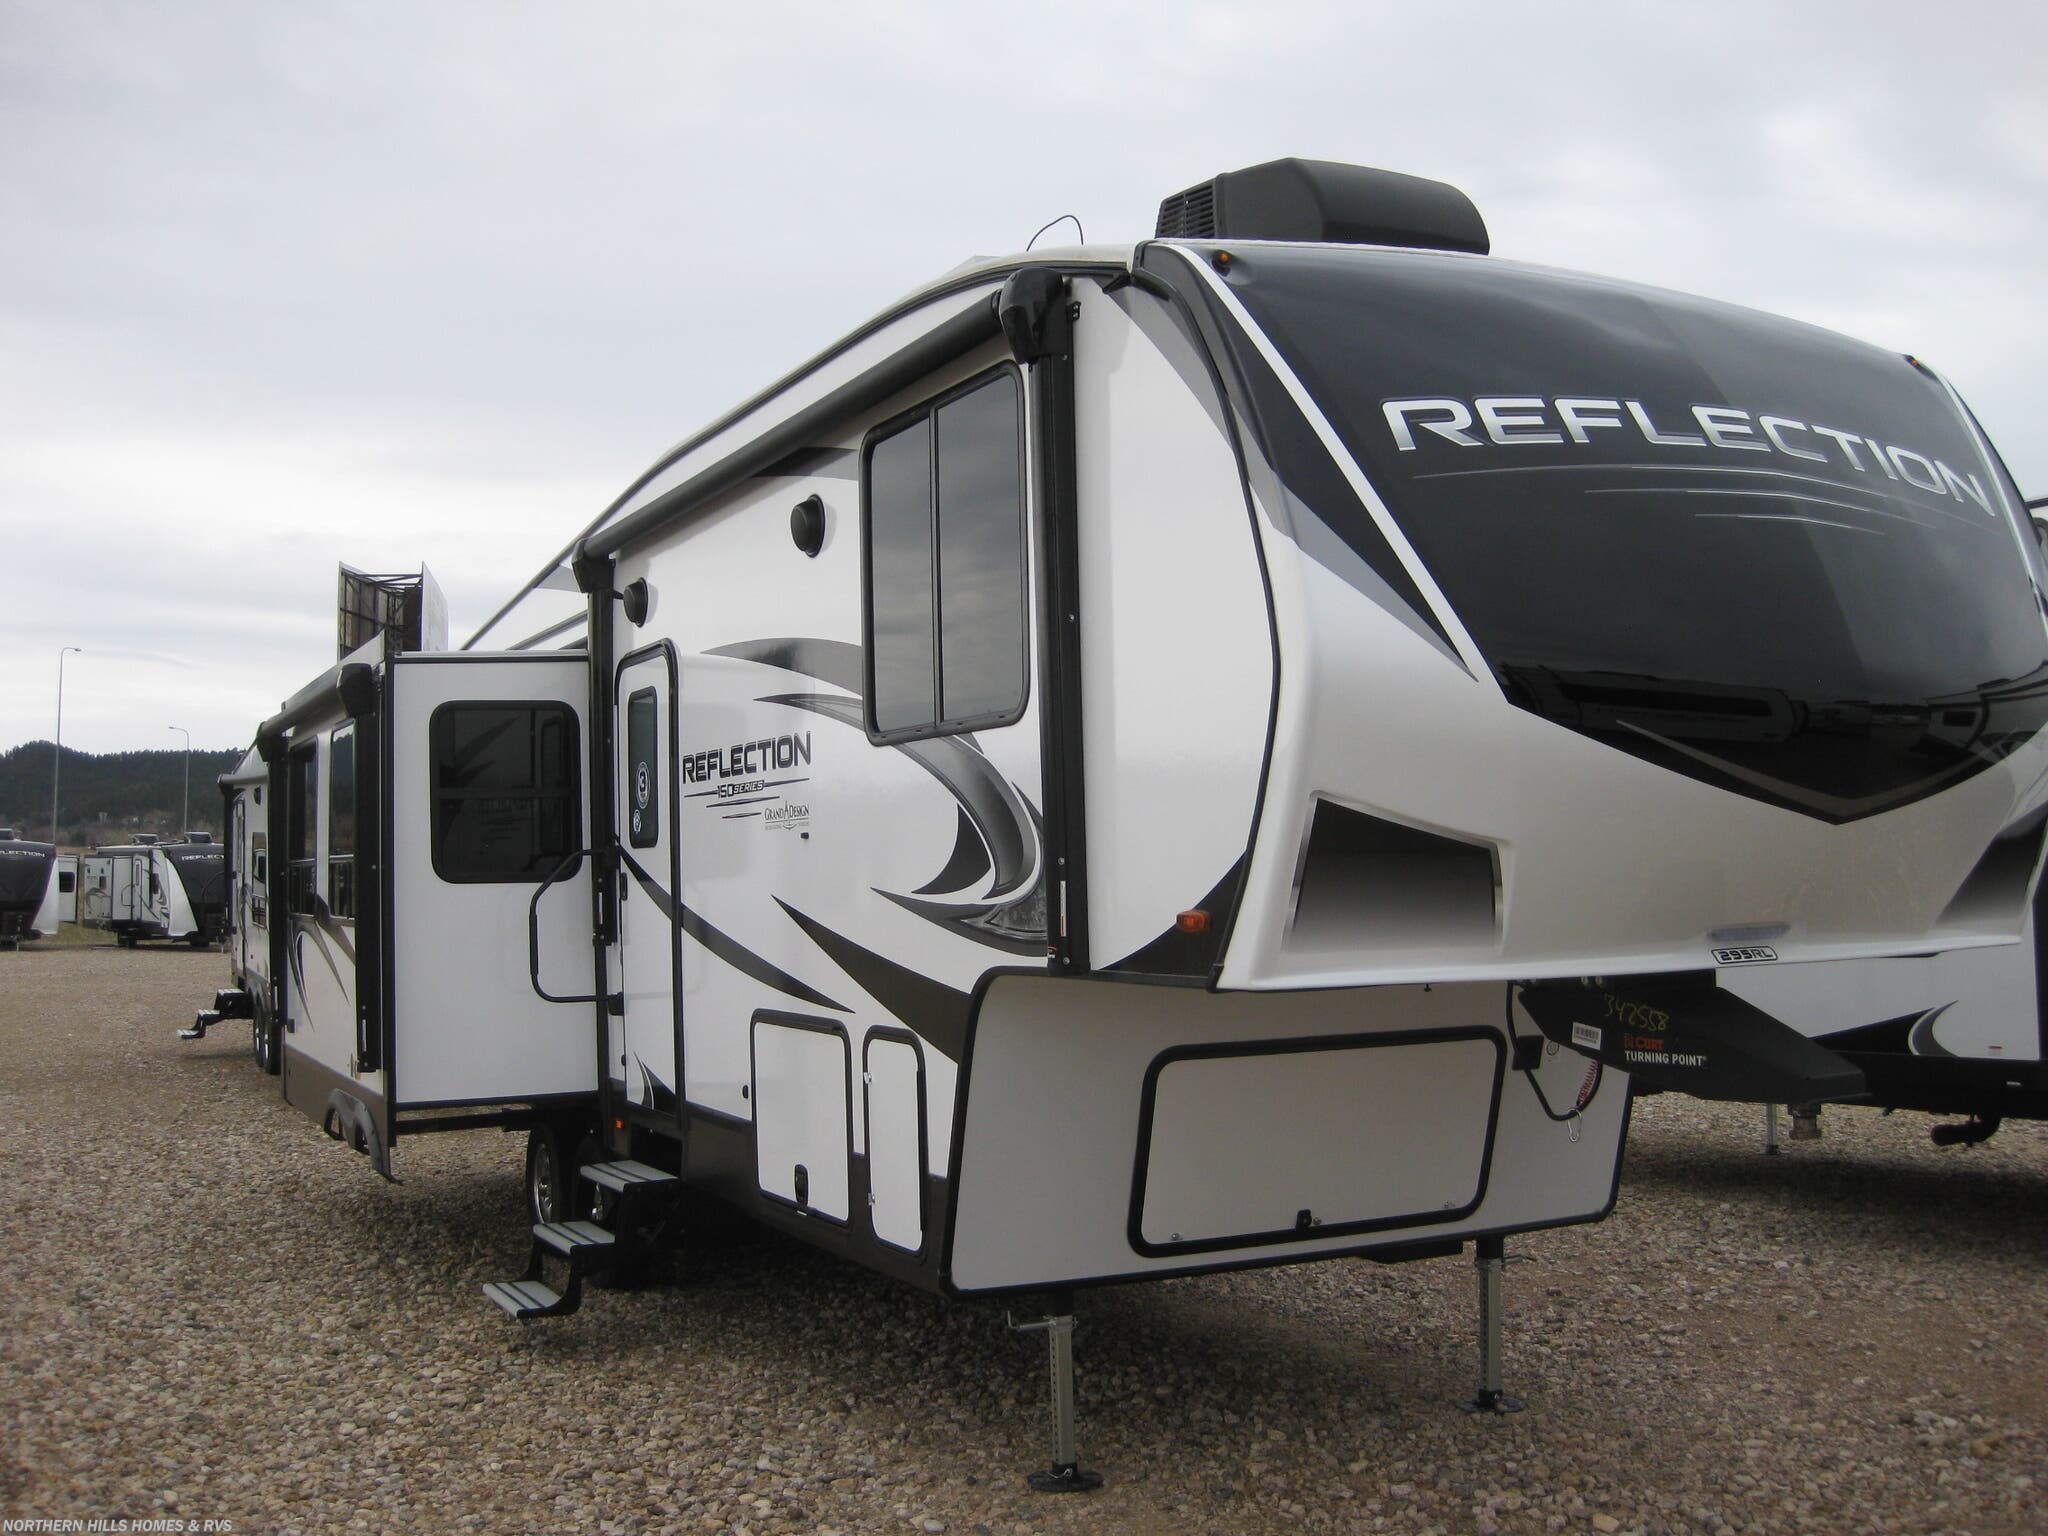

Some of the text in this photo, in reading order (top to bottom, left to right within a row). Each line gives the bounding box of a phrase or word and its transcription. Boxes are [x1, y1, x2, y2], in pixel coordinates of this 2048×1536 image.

[1381, 396, 1996, 517] REFLECTION
[682, 731, 812, 784] REFLECTION
[1718, 948, 1774, 961] 295RL
[1624, 1051, 1670, 1064] TURNING
